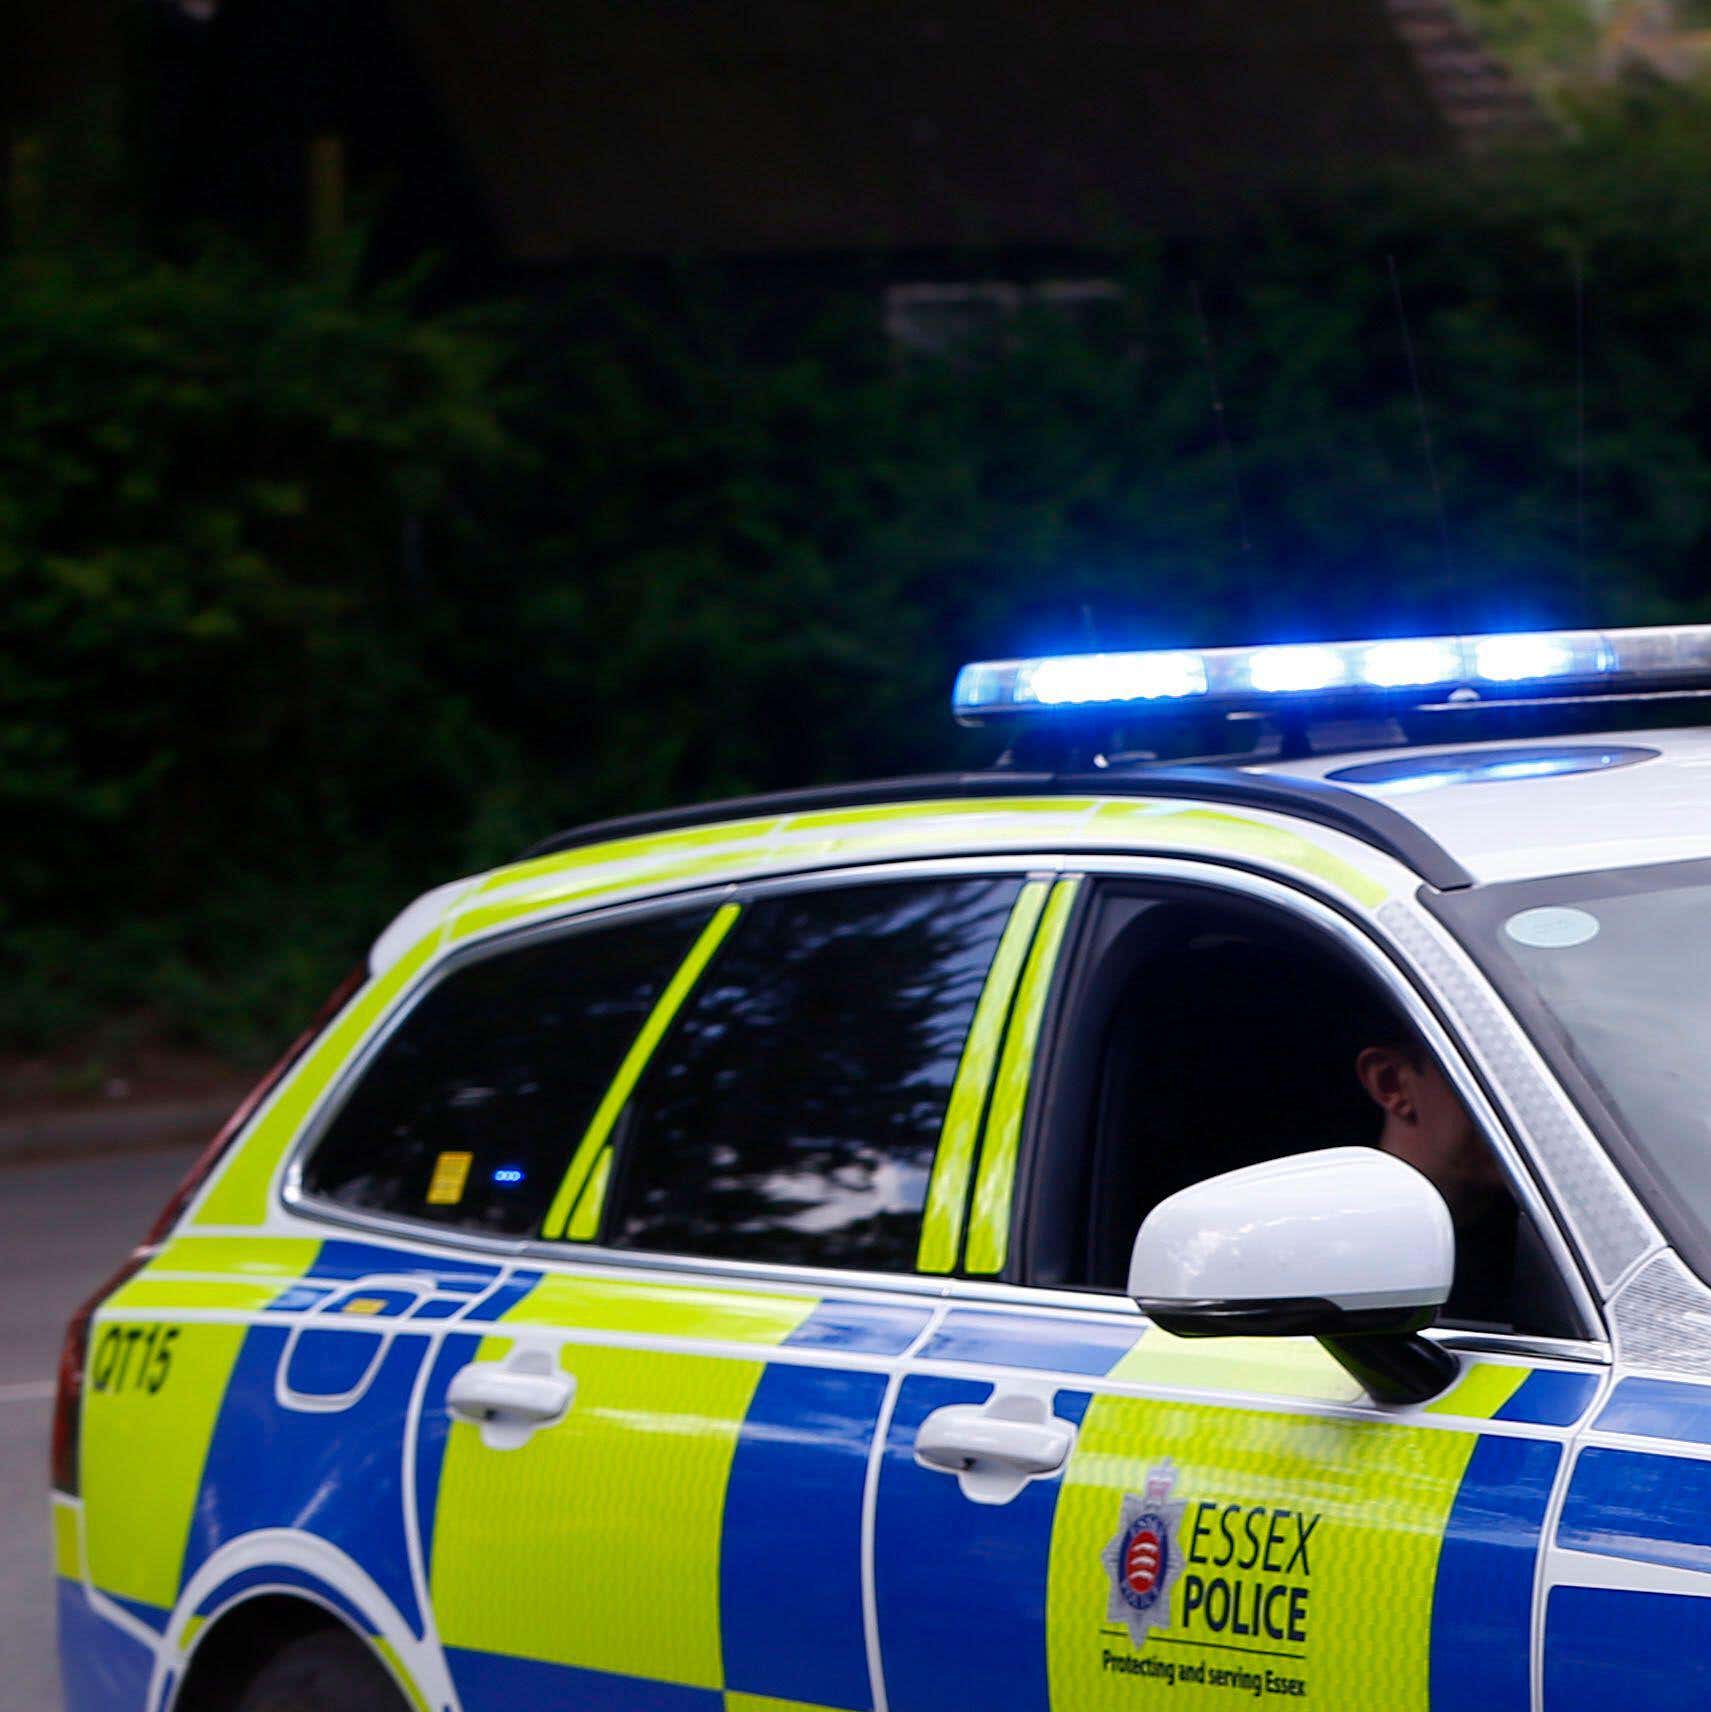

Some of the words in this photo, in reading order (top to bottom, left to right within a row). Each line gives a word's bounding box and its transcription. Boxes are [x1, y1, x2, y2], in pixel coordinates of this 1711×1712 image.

[92, 1326, 181, 1396] QT15
[1188, 1502, 1322, 1576] ESSEX
[1182, 1574, 1309, 1643] POLICE
[1103, 1649, 1176, 1686] Protecting
[1178, 1659, 1206, 1684] and
[1208, 1666, 1263, 1697] serving
[1264, 1669, 1307, 1697] Essex
